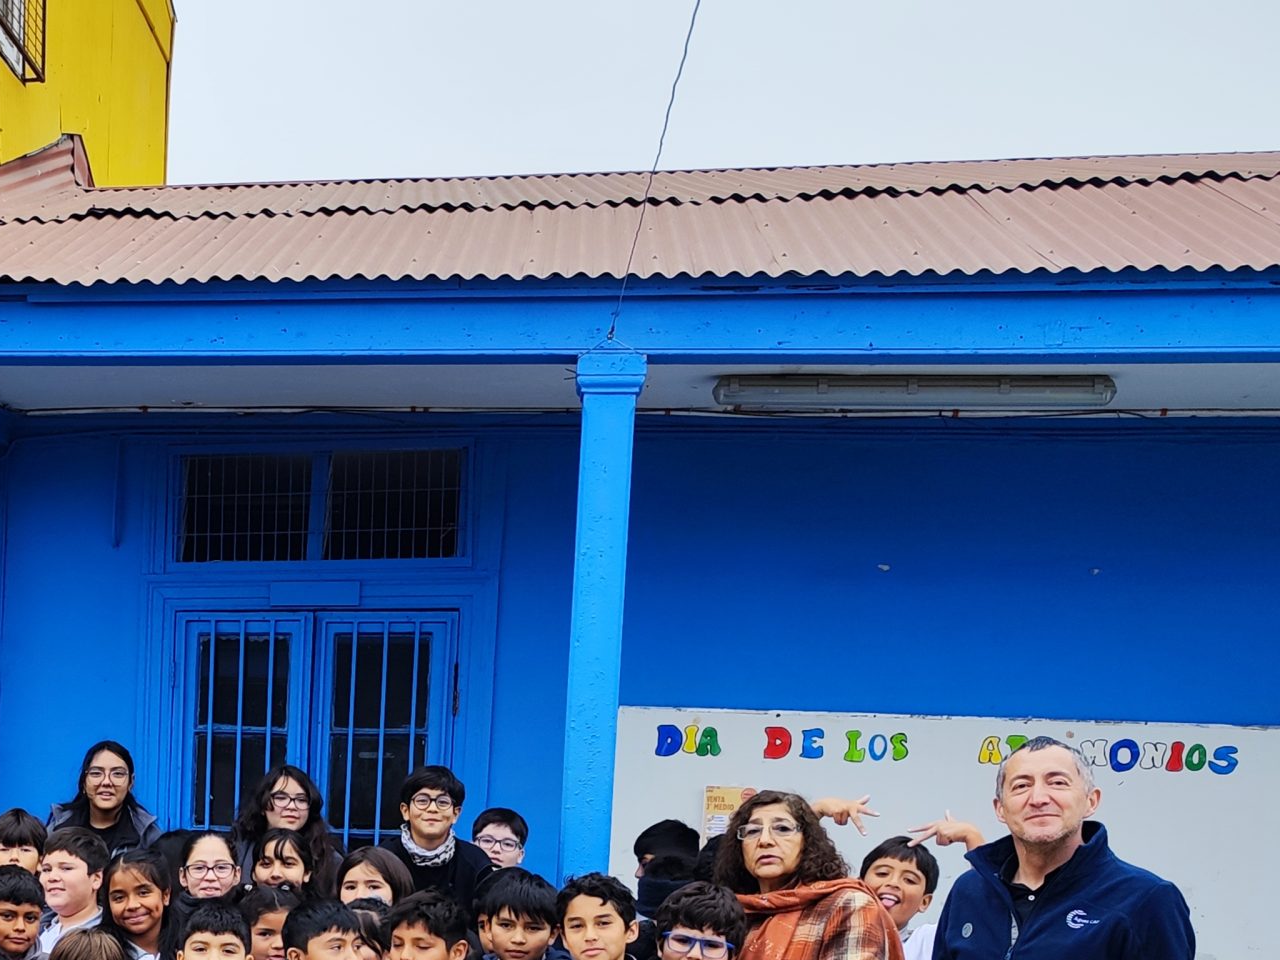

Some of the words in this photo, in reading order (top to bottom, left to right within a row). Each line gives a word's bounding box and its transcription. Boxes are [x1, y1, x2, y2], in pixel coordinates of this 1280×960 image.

[763, 726, 824, 759] DE
[843, 730, 908, 762] LOS
[978, 735, 1239, 774] AMONIOS
